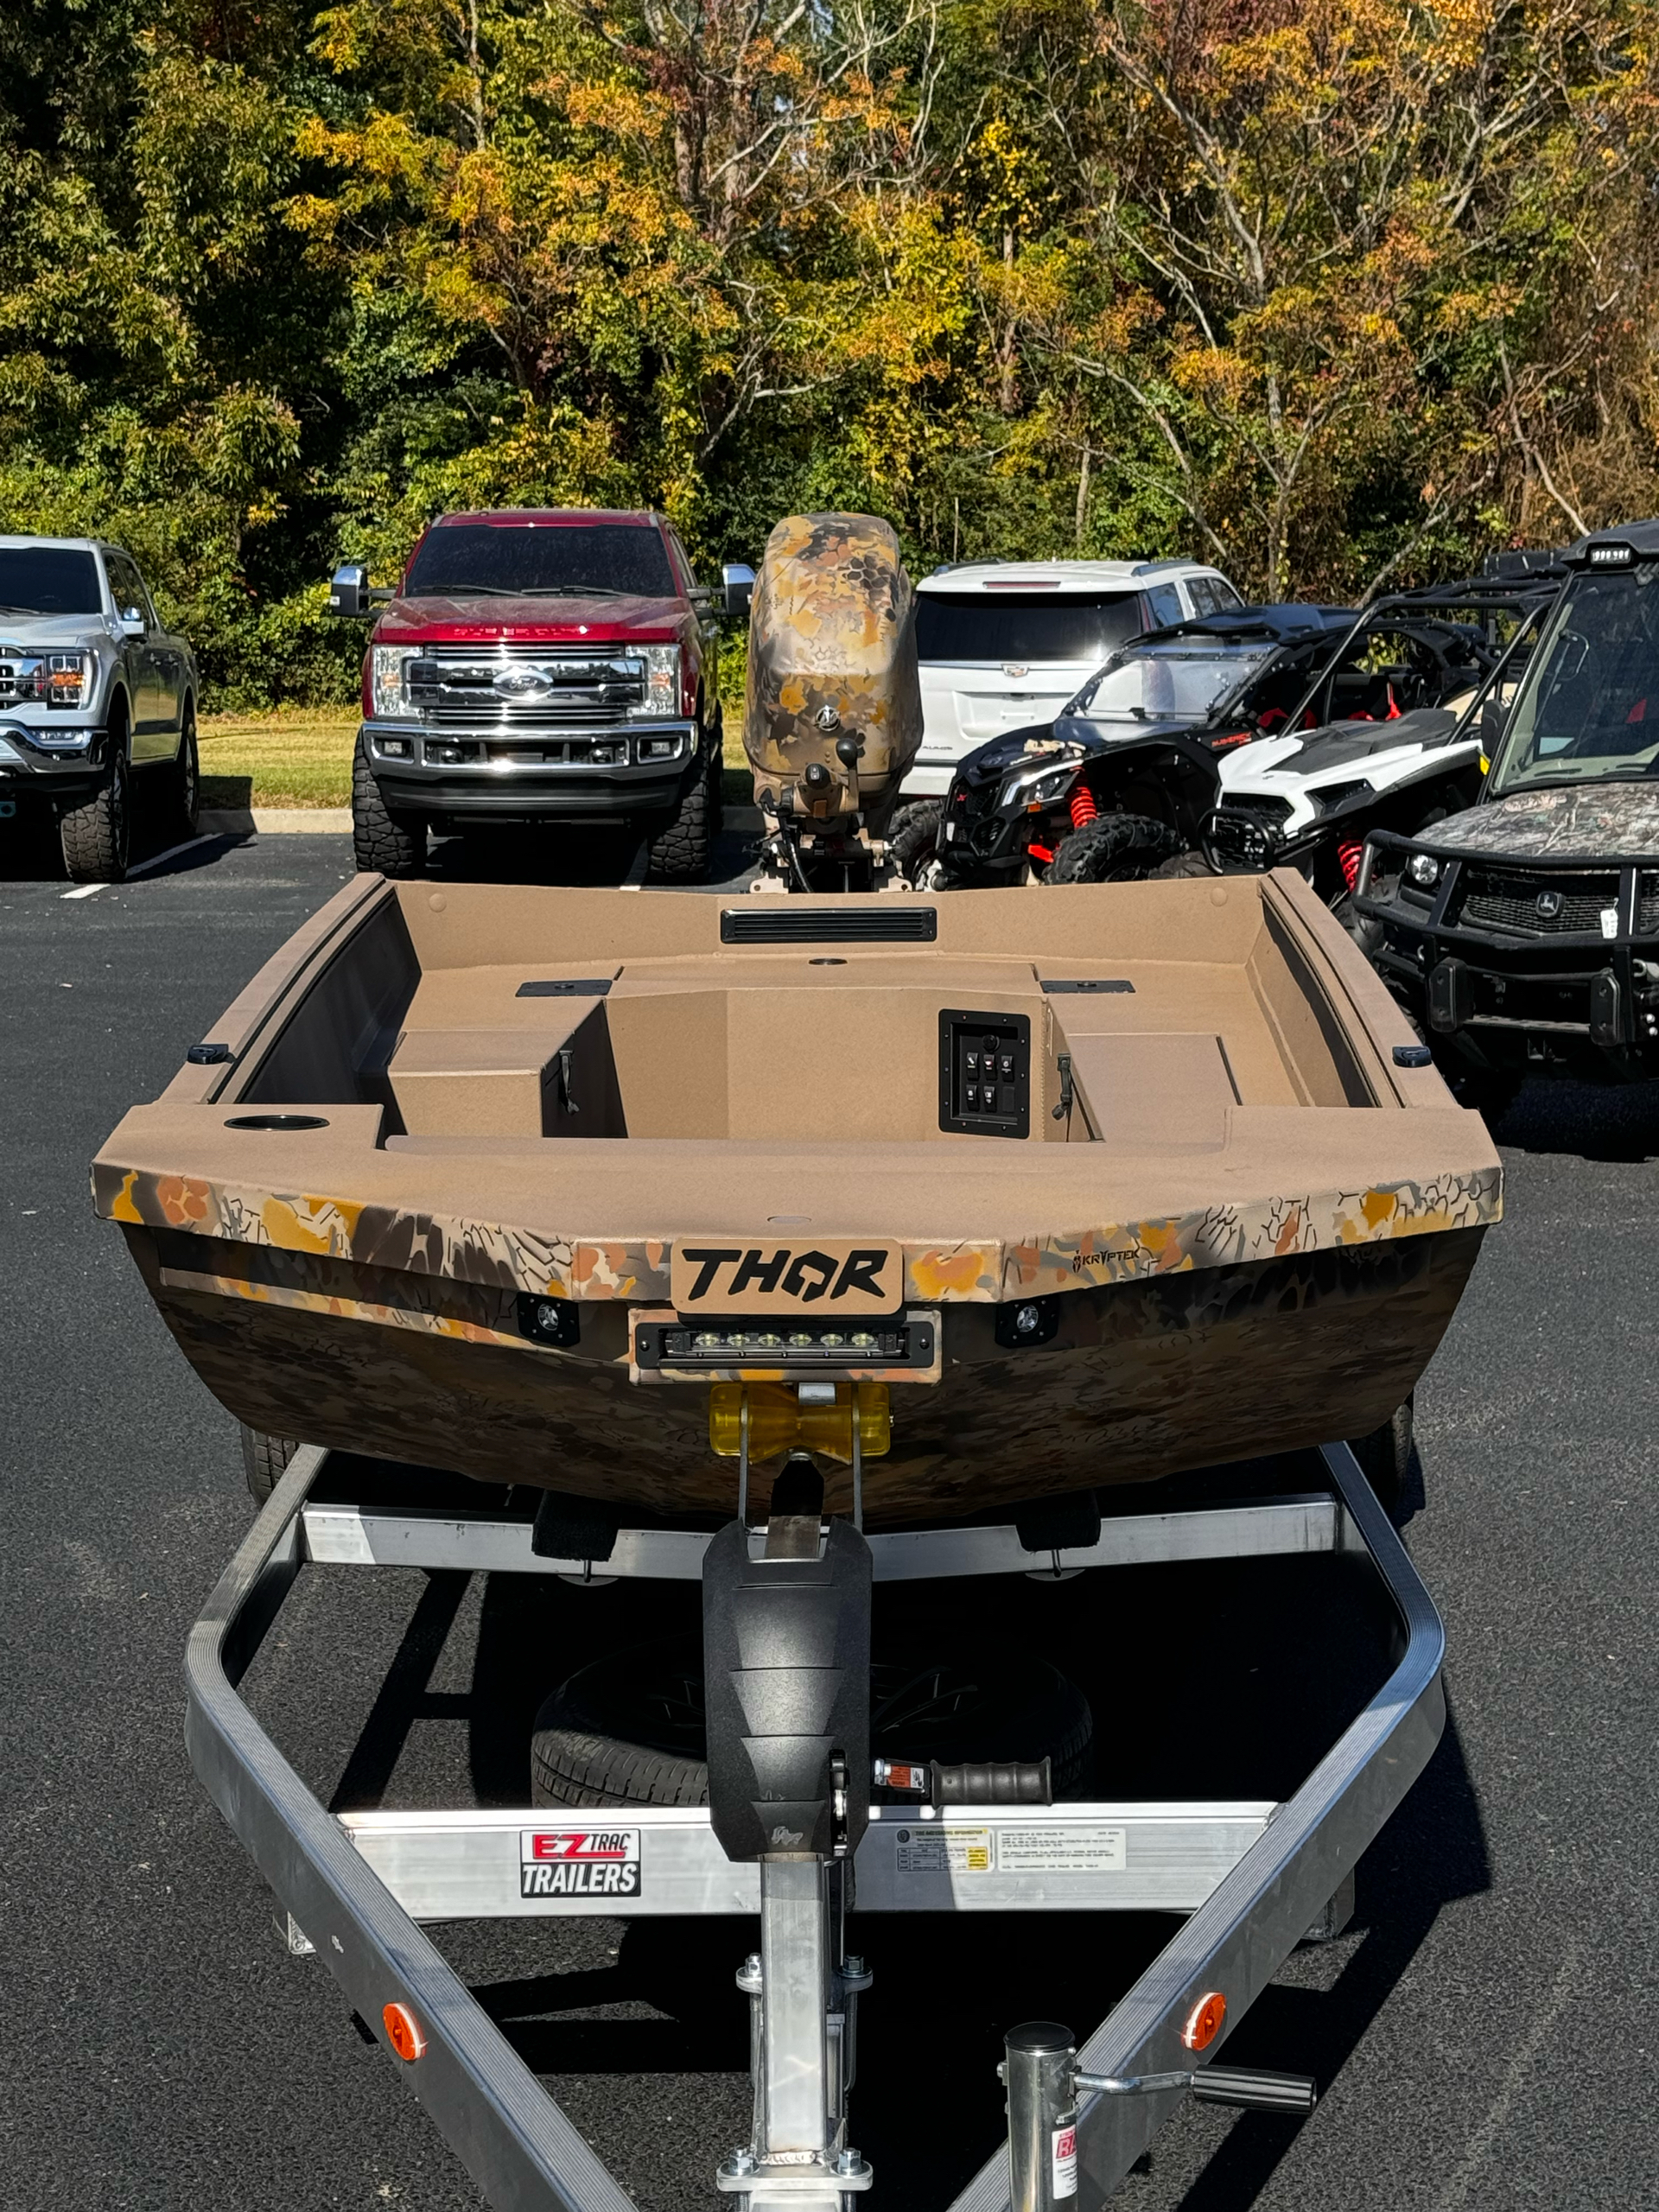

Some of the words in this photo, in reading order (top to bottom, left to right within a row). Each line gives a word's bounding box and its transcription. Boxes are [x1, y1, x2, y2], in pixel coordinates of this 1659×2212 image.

[509, 676, 537, 690] Ford
[1082, 1249, 1140, 1266] KRYPTEK
[682, 1249, 888, 1302] THOR
[590, 1834, 631, 1851] TRAC
[522, 1863, 638, 1893] TRAILERS
